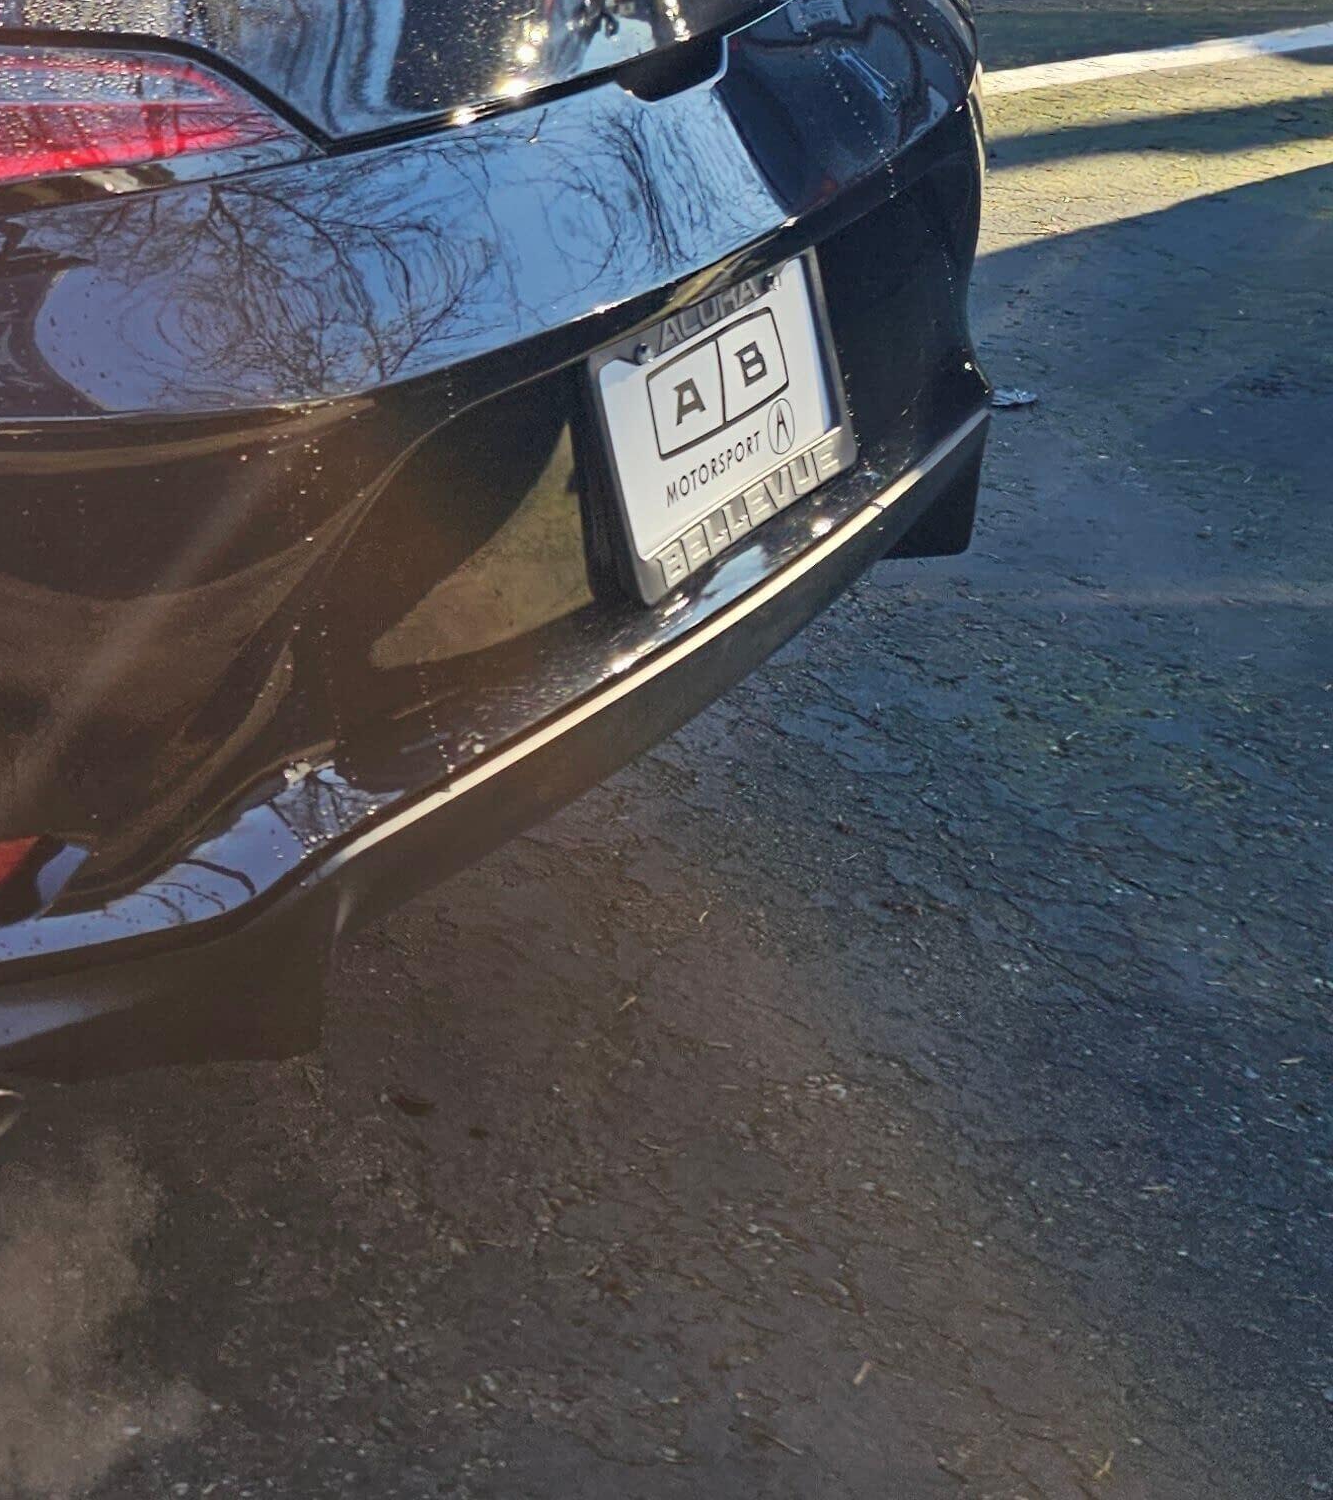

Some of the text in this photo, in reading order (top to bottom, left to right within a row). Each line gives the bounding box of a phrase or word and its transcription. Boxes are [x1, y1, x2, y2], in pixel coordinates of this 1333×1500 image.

[658, 279, 761, 351] ACURA
[673, 340, 768, 426] A B
[665, 430, 762, 508] MOTORSPORT
[656, 437, 841, 590] BELLEVUE
